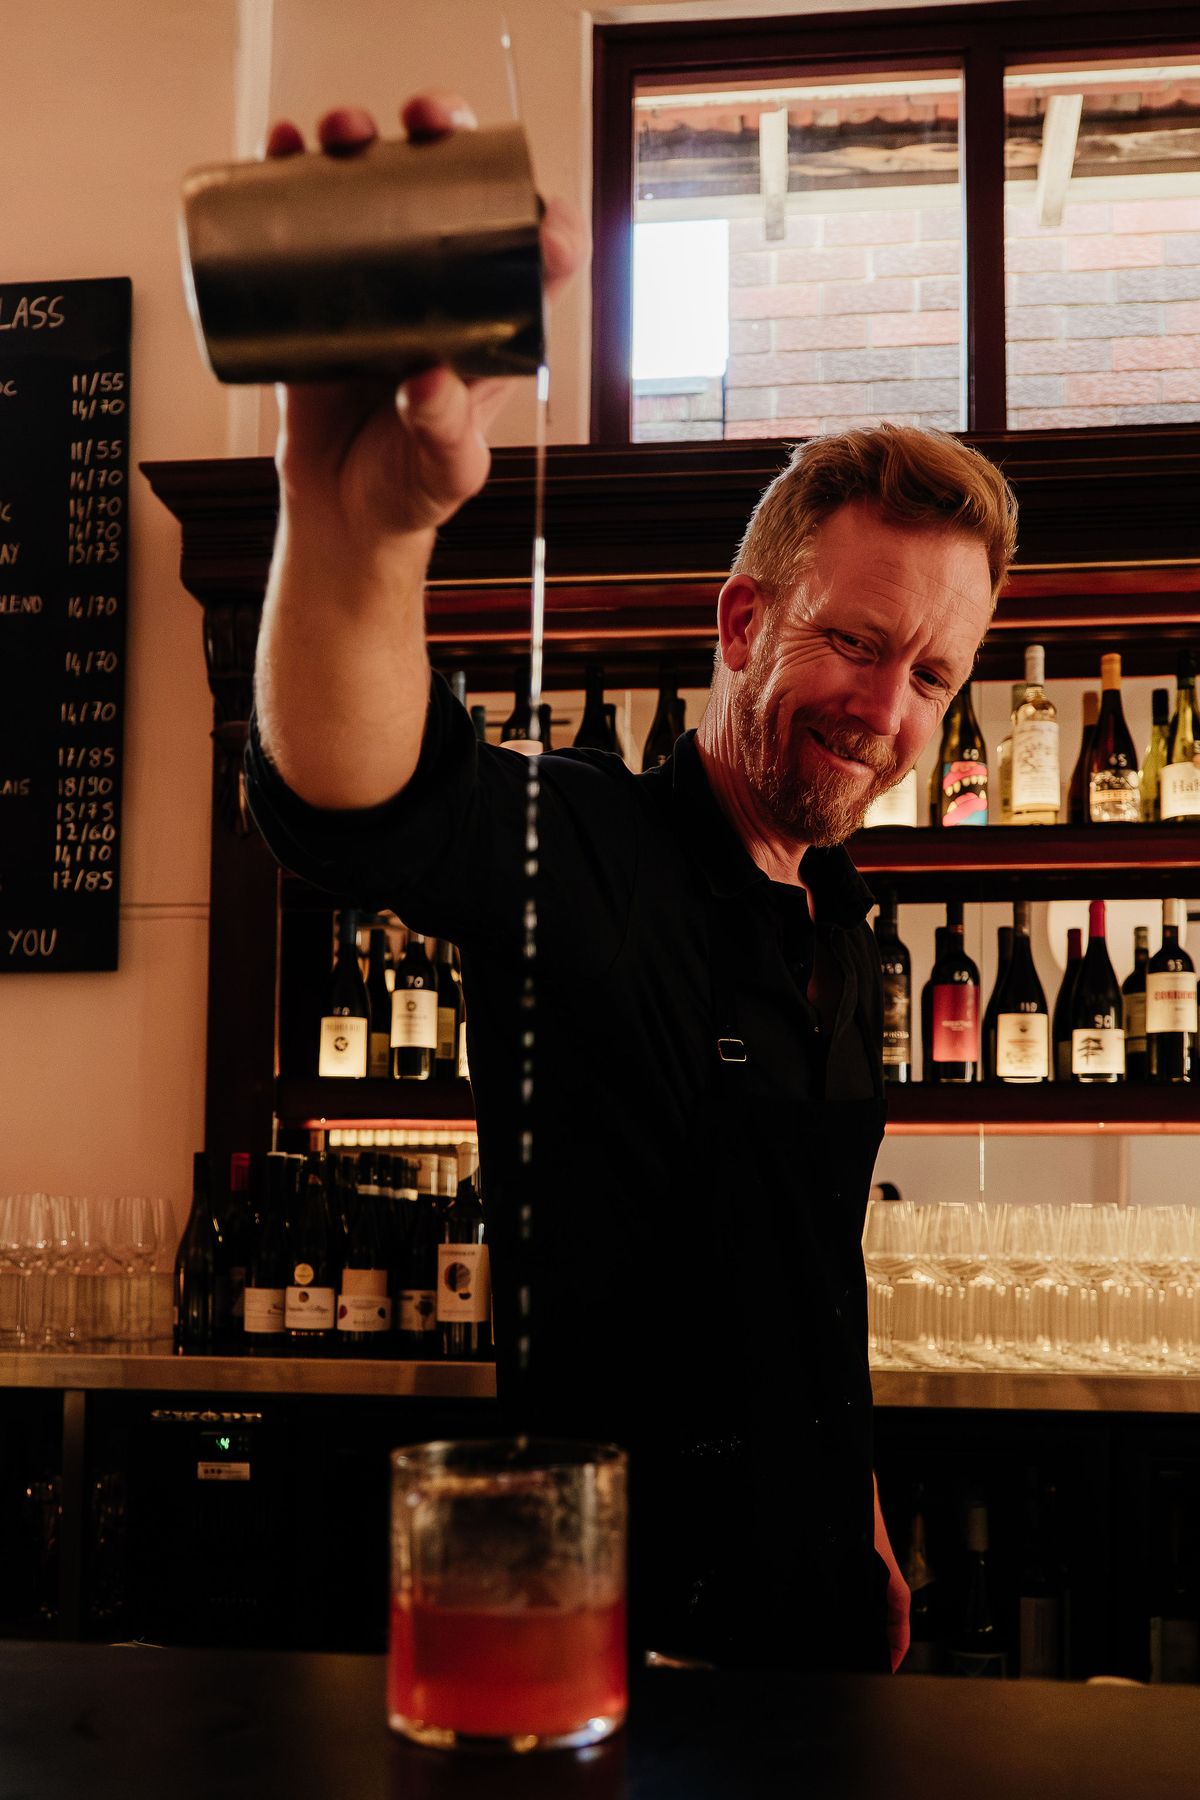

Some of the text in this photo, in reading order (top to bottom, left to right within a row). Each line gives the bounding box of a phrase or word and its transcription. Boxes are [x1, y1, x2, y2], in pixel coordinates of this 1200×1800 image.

[72, 371, 124, 397] 11/55
[70, 438, 122, 466] 11/55
[0, 594, 43, 614] LEND
[58, 746, 116, 769] 17/85
[0, 775, 114, 798] AIS 18/90
[52, 869, 114, 893] 17/85
[8, 929, 57, 956] YOU
